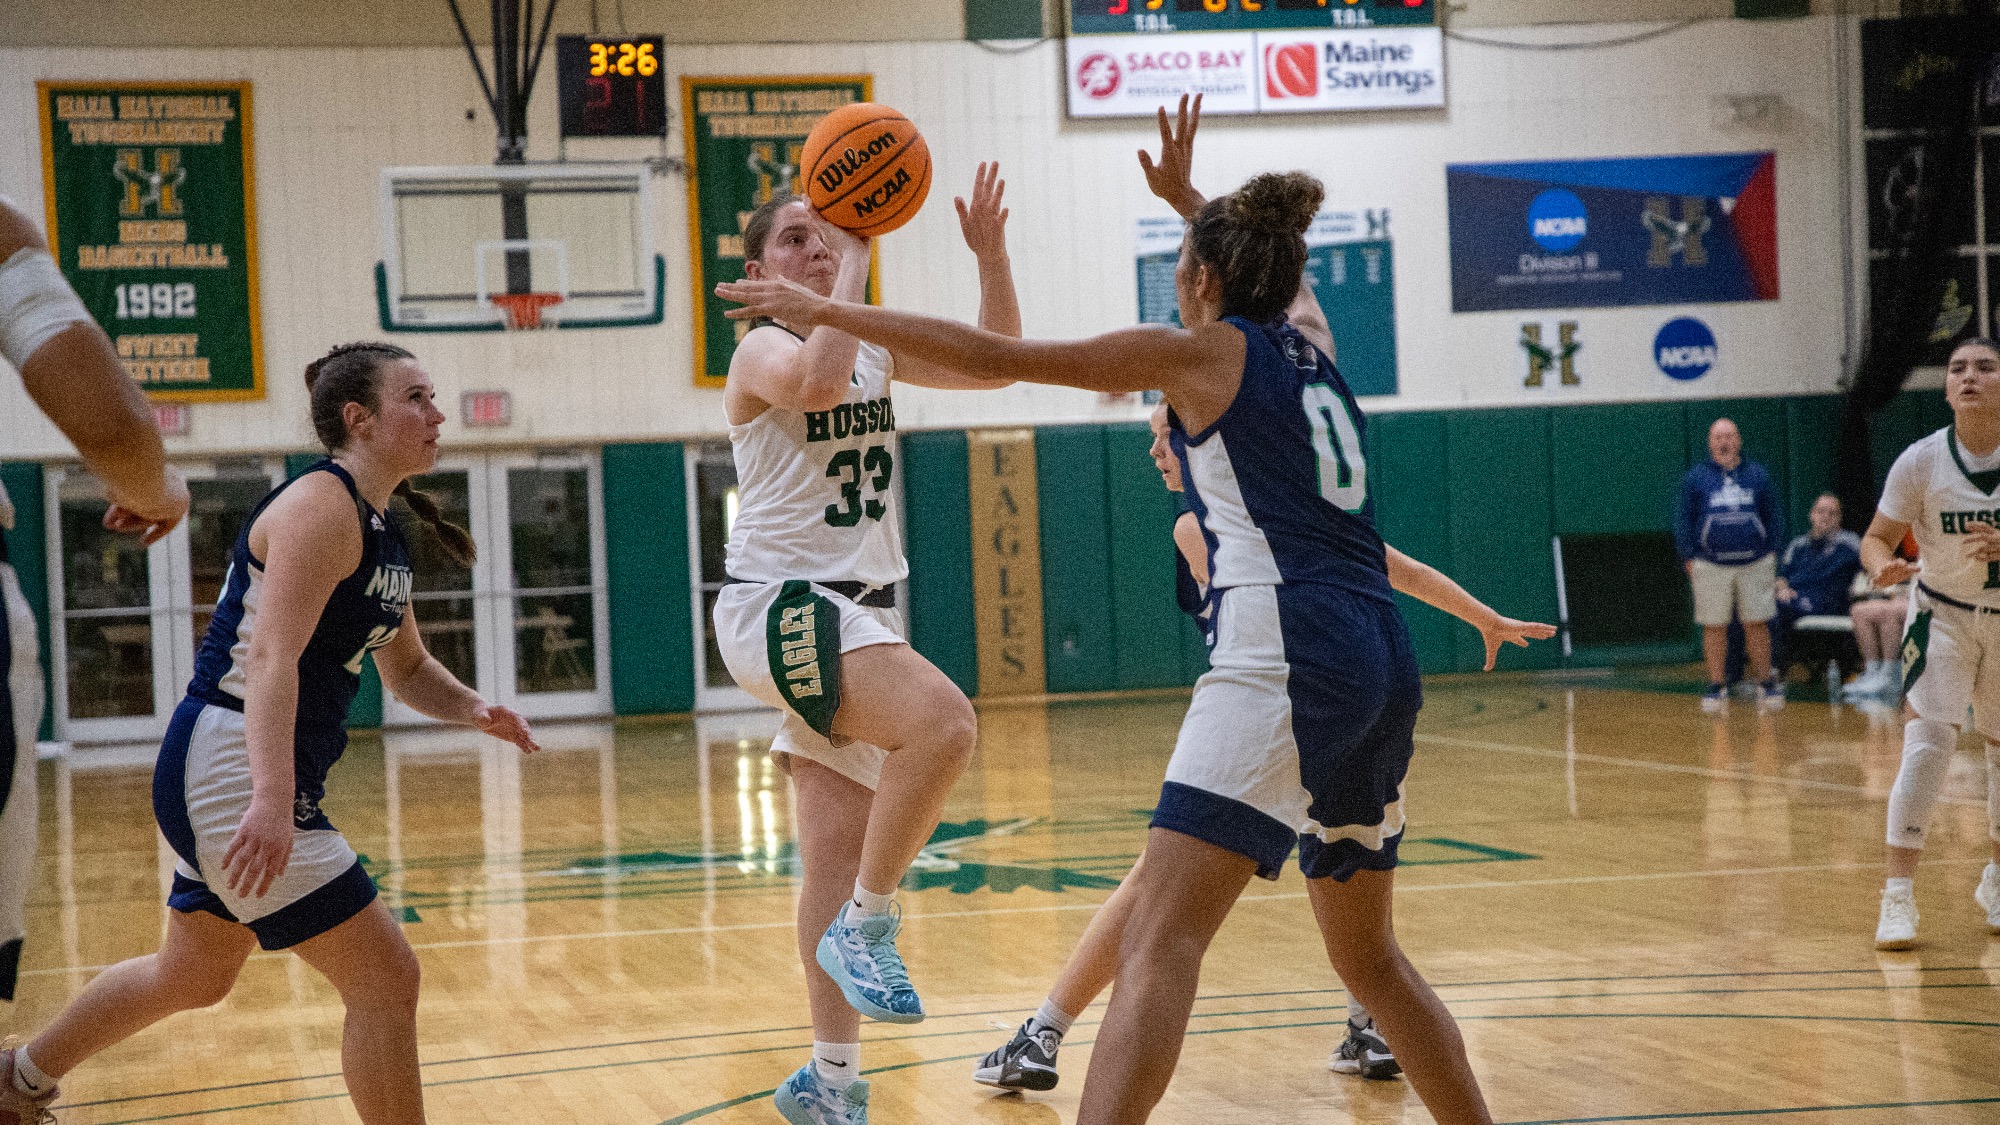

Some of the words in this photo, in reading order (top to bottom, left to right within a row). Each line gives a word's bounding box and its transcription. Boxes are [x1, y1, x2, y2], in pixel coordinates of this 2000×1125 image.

[589, 43, 658, 76] 3:26
[1126, 51, 1192, 71] SACO
[1199, 50, 1244, 68] BAY
[1325, 38, 1414, 63] Maine
[1326, 64, 1435, 94] Savings
[817, 131, 898, 193] Wilson
[852, 167, 912, 218] NCAA
[1534, 216, 1588, 238] NCAA
[115, 282, 197, 319] 1992
[1660, 346, 1717, 368] NCAA
[804, 397, 895, 443] HUSSO
[1302, 381, 1367, 514] 0
[824, 445, 893, 527] 33
[992, 442, 1027, 680] EAGLES
[780, 602, 823, 699] EAGLES
